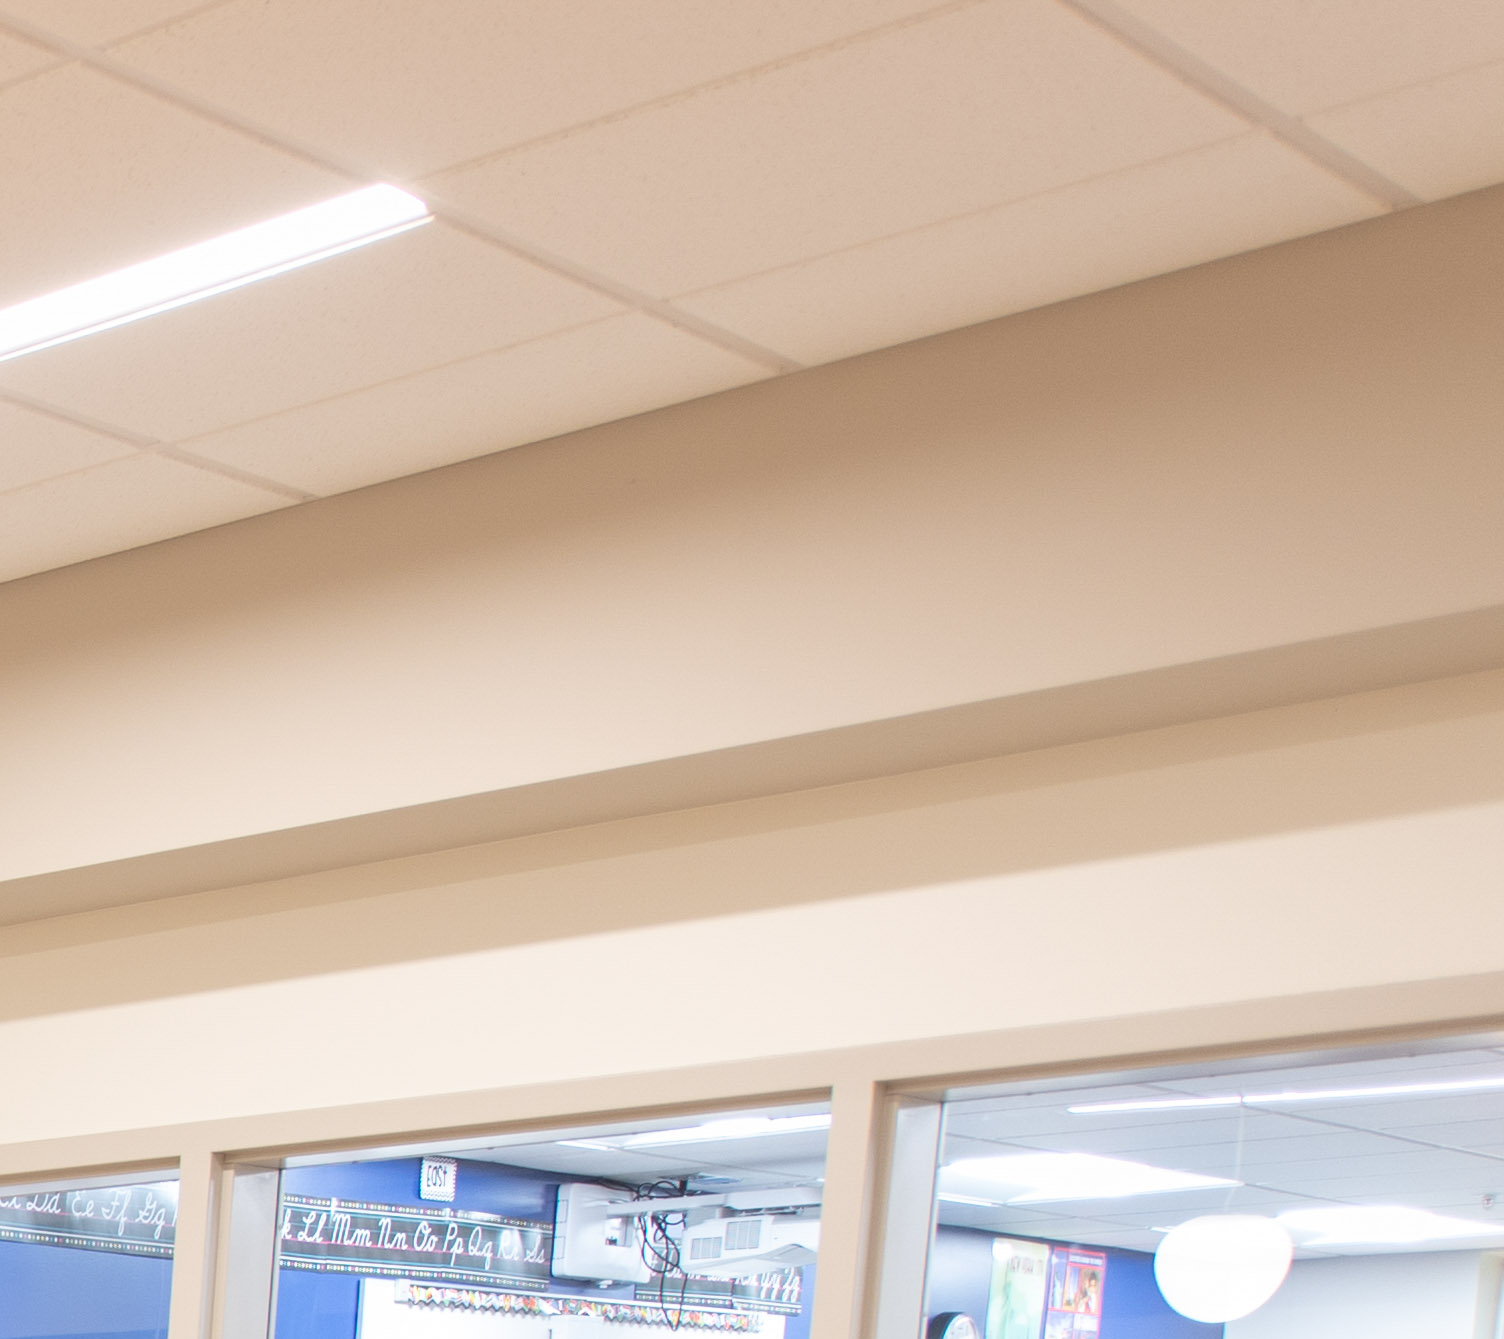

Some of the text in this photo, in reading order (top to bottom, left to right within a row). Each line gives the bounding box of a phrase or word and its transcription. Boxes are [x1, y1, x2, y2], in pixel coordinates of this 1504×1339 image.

[331, 1212, 373, 1247] Mm
[377, 1216, 409, 1250] Nn
[413, 1221, 438, 1252] Oo
[442, 1222, 464, 1267] Pp
